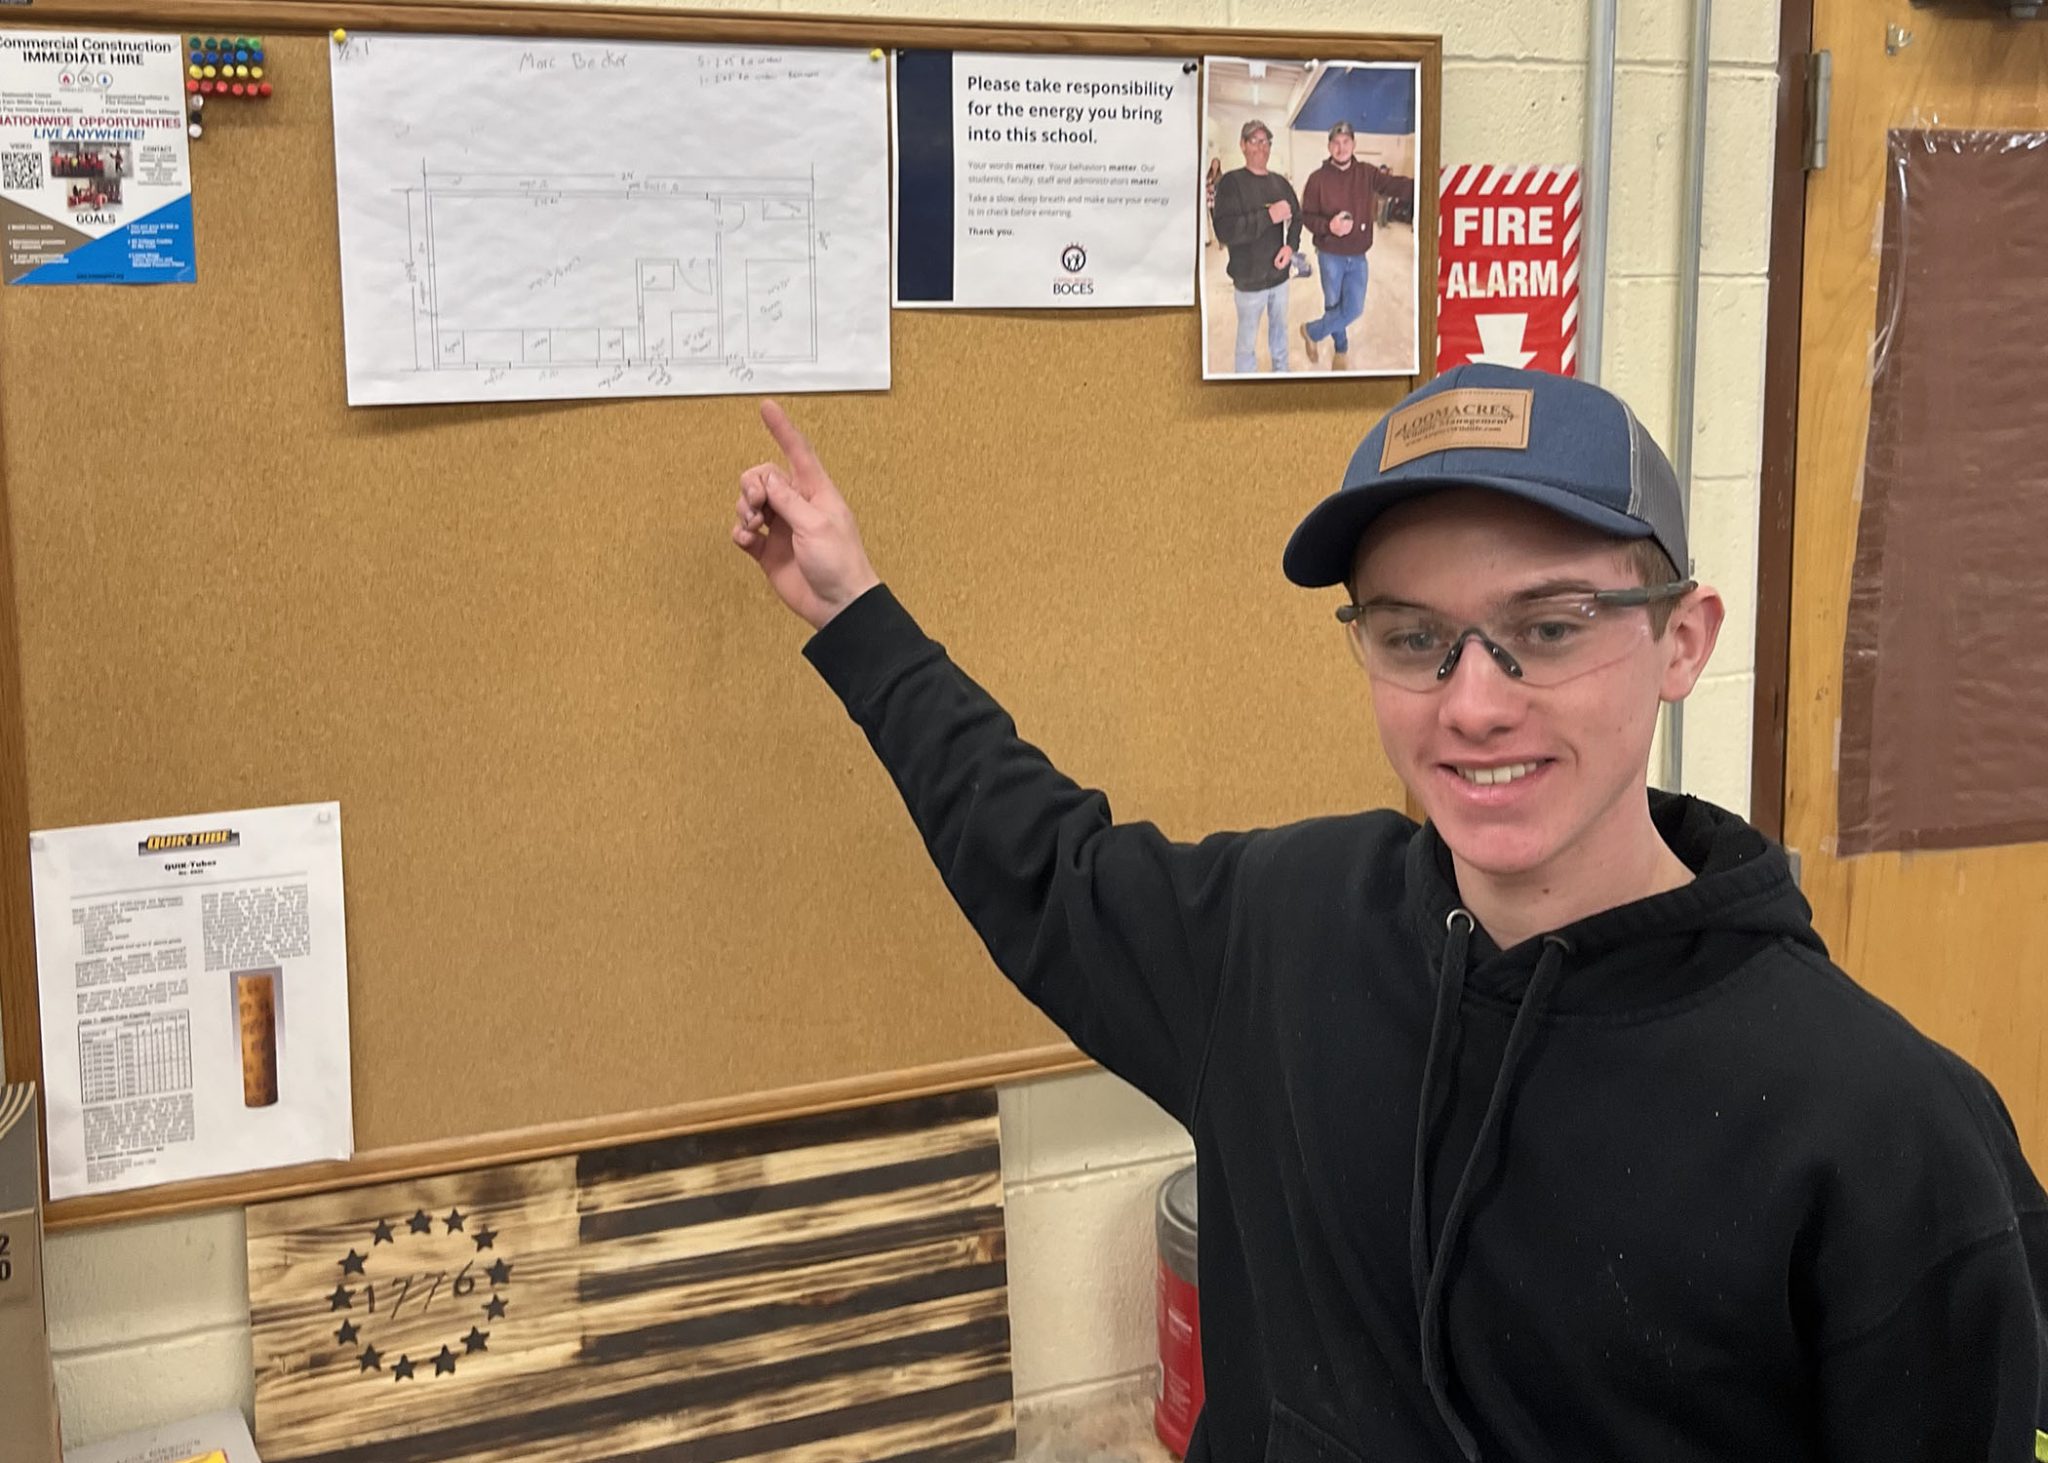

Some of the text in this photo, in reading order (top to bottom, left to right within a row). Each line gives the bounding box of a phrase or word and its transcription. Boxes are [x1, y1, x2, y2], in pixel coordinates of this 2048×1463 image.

[82, 38, 171, 54] Construction
[23, 52, 144, 66] IMMEDIATE HIRE
[968, 76, 1174, 100] Please take responsibility
[968, 100, 1163, 124] for the energy you bring
[79, 116, 182, 129] OPPORTUNITIES
[34, 128, 145, 141] LIVE ANYWHERE!
[968, 126, 1098, 144] into this school.
[968, 162, 988, 170] Your
[989, 162, 1014, 170] words
[1049, 162, 1068, 172] Your
[1070, 162, 1107, 172] behaviors
[1140, 164, 1156, 172] Our
[1037, 175, 1056, 184] staff
[1056, 176, 1072, 185] and
[1073, 176, 1129, 186] administrators
[968, 194, 988, 203] Take
[1018, 194, 1037, 206] deep
[1040, 194, 1065, 204] breath
[1066, 194, 1082, 204] and
[1084, 195, 1104, 204] make
[1106, 197, 1122, 205] sure
[1124, 197, 1141, 206] your
[1144, 197, 1170, 206] energy
[76, 213, 116, 224] GOALS
[968, 208, 974, 216] is
[976, 208, 984, 216] in
[986, 208, 1008, 217] check
[1010, 208, 1036, 218] before
[1453, 206, 1554, 246] FIRE
[968, 228, 1014, 238] Thank you.
[1446, 260, 1558, 300] ALARM
[1054, 283, 1094, 295] BOCES
[1439, 418, 1508, 428] Management
[364, 1259, 476, 1320] 1776
